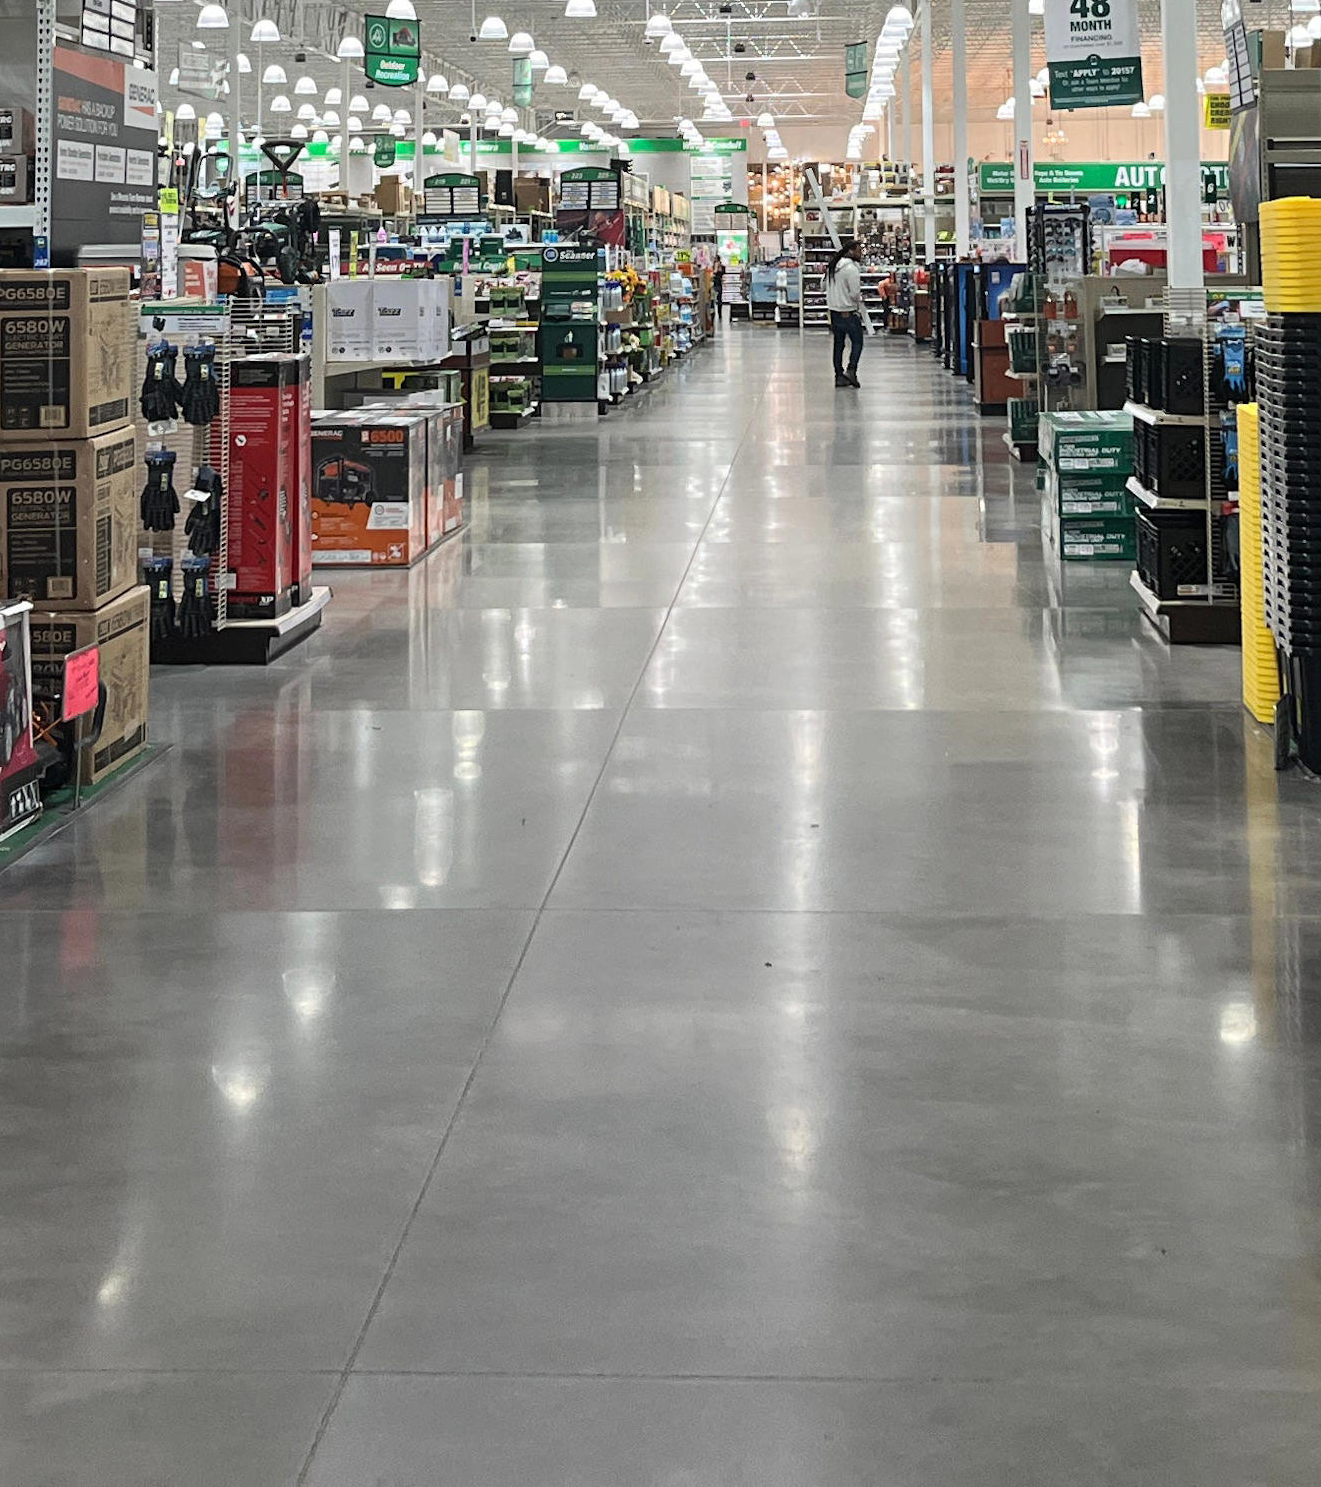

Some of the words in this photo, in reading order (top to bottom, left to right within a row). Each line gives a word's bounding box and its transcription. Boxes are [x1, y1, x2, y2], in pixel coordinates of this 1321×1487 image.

[1070, 20, 1111, 32] MONTH
[560, 250, 595, 260] Scanner
[5, 320, 66, 334] 6580W
[5, 341, 64, 350] GENERATOR
[371, 430, 404, 442] 6500
[1, 457, 72, 470] PG6580E
[12, 490, 71, 504] 6580W
